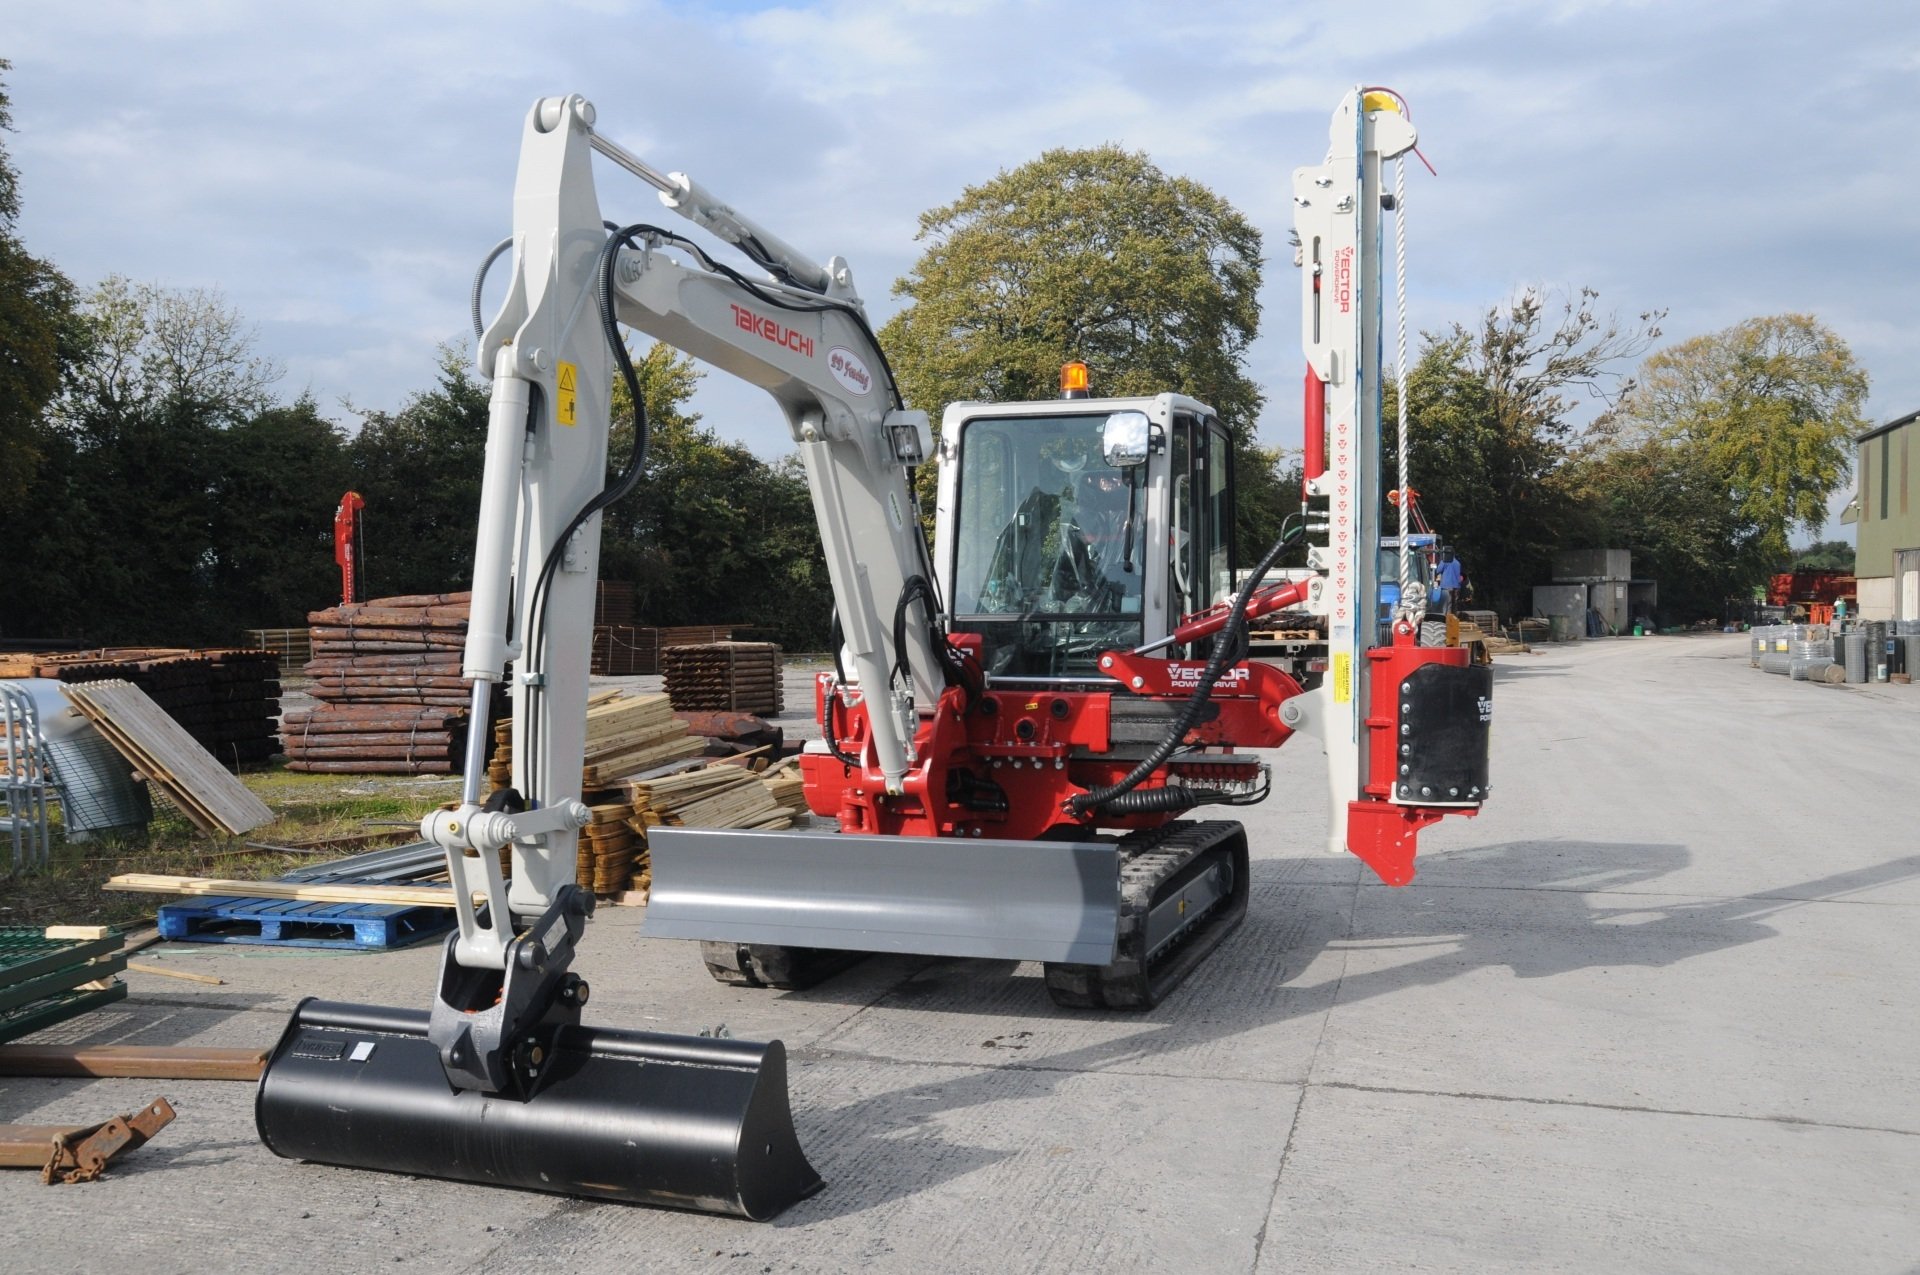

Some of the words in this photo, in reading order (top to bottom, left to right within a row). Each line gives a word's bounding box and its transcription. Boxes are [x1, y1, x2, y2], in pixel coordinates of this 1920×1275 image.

[1341, 246, 1353, 312] VECTOR
[1167, 663, 1249, 680] VECOR
[1171, 680, 1238, 688] POWERIVE
